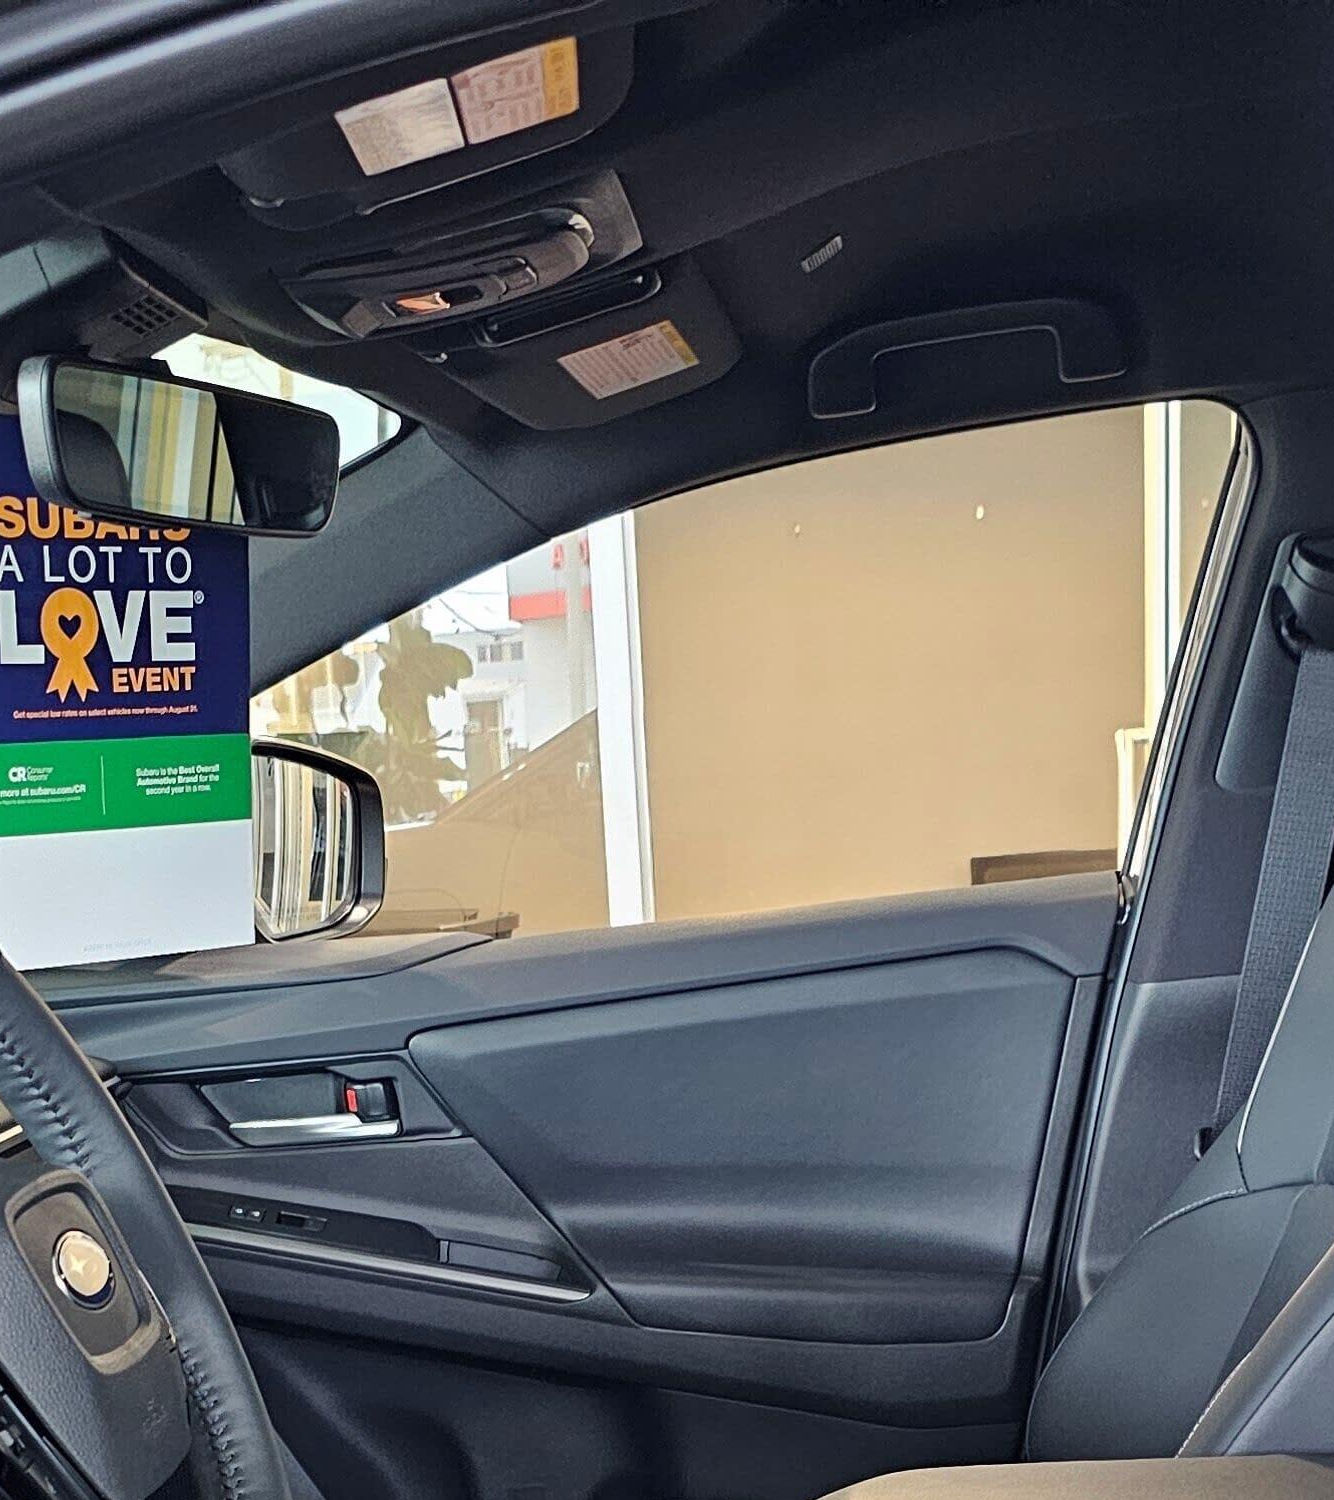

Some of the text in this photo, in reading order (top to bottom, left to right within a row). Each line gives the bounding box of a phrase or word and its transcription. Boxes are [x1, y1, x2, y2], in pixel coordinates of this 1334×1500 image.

[43, 545, 122, 583] LOT
[138, 546, 192, 583] TO
[112, 666, 196, 692] EVENT
[26, 710, 49, 719] special
[88, 708, 107, 717] select
[107, 707, 131, 716] vehicles
[146, 706, 168, 716] through
[169, 705, 189, 715] August
[8, 766, 27, 782] CR
[136, 767, 160, 777] Subaru
[167, 766, 178, 775] the
[179, 765, 195, 775] Best
[196, 763, 220, 773] Overall
[137, 773, 220, 786] Automotive Brand for the
[0, 789, 20, 798] more
[20, 787, 30, 797] at
[30, 783, 86, 796] subaru.com/CR
[146, 785, 171, 796] second
[171, 785, 185, 796] year
